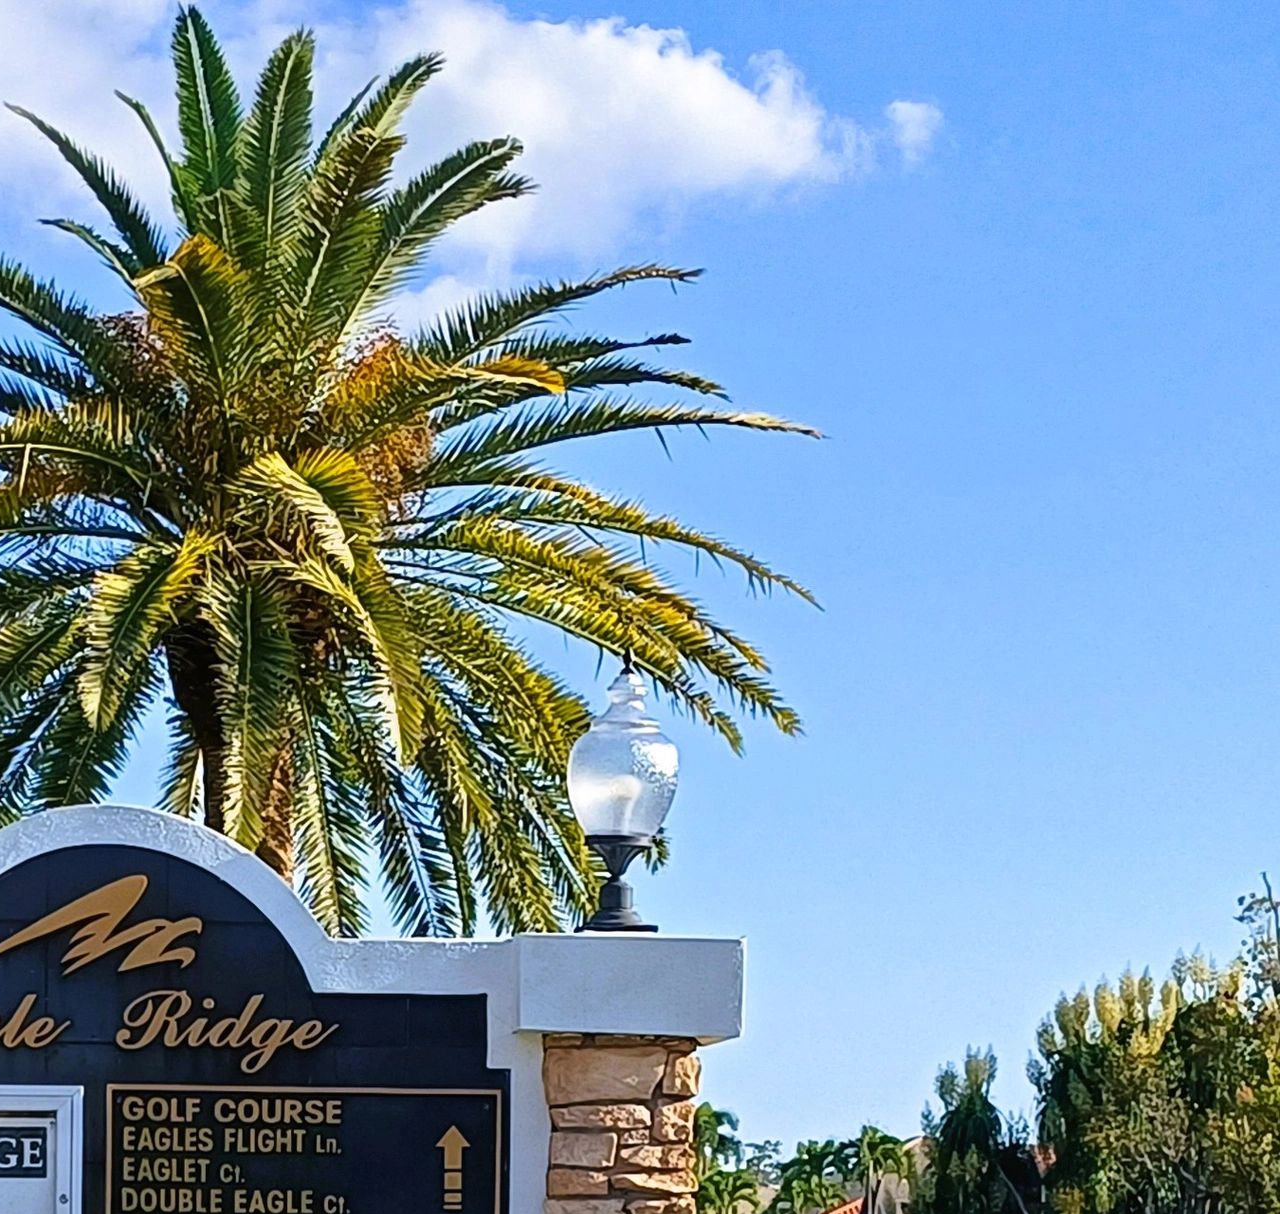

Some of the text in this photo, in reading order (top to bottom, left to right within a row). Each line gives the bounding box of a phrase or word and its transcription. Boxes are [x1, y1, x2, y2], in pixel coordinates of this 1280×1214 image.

[115, 990, 339, 1074] Ridge
[122, 1096, 342, 1124] GOLF COURSE
[123, 1126, 342, 1154] EAGLES FLIGHT Ln.
[123, 1157, 246, 1183] EAGLET Ct.
[121, 1187, 350, 1214] DOUBLE EAGLE Ct.
